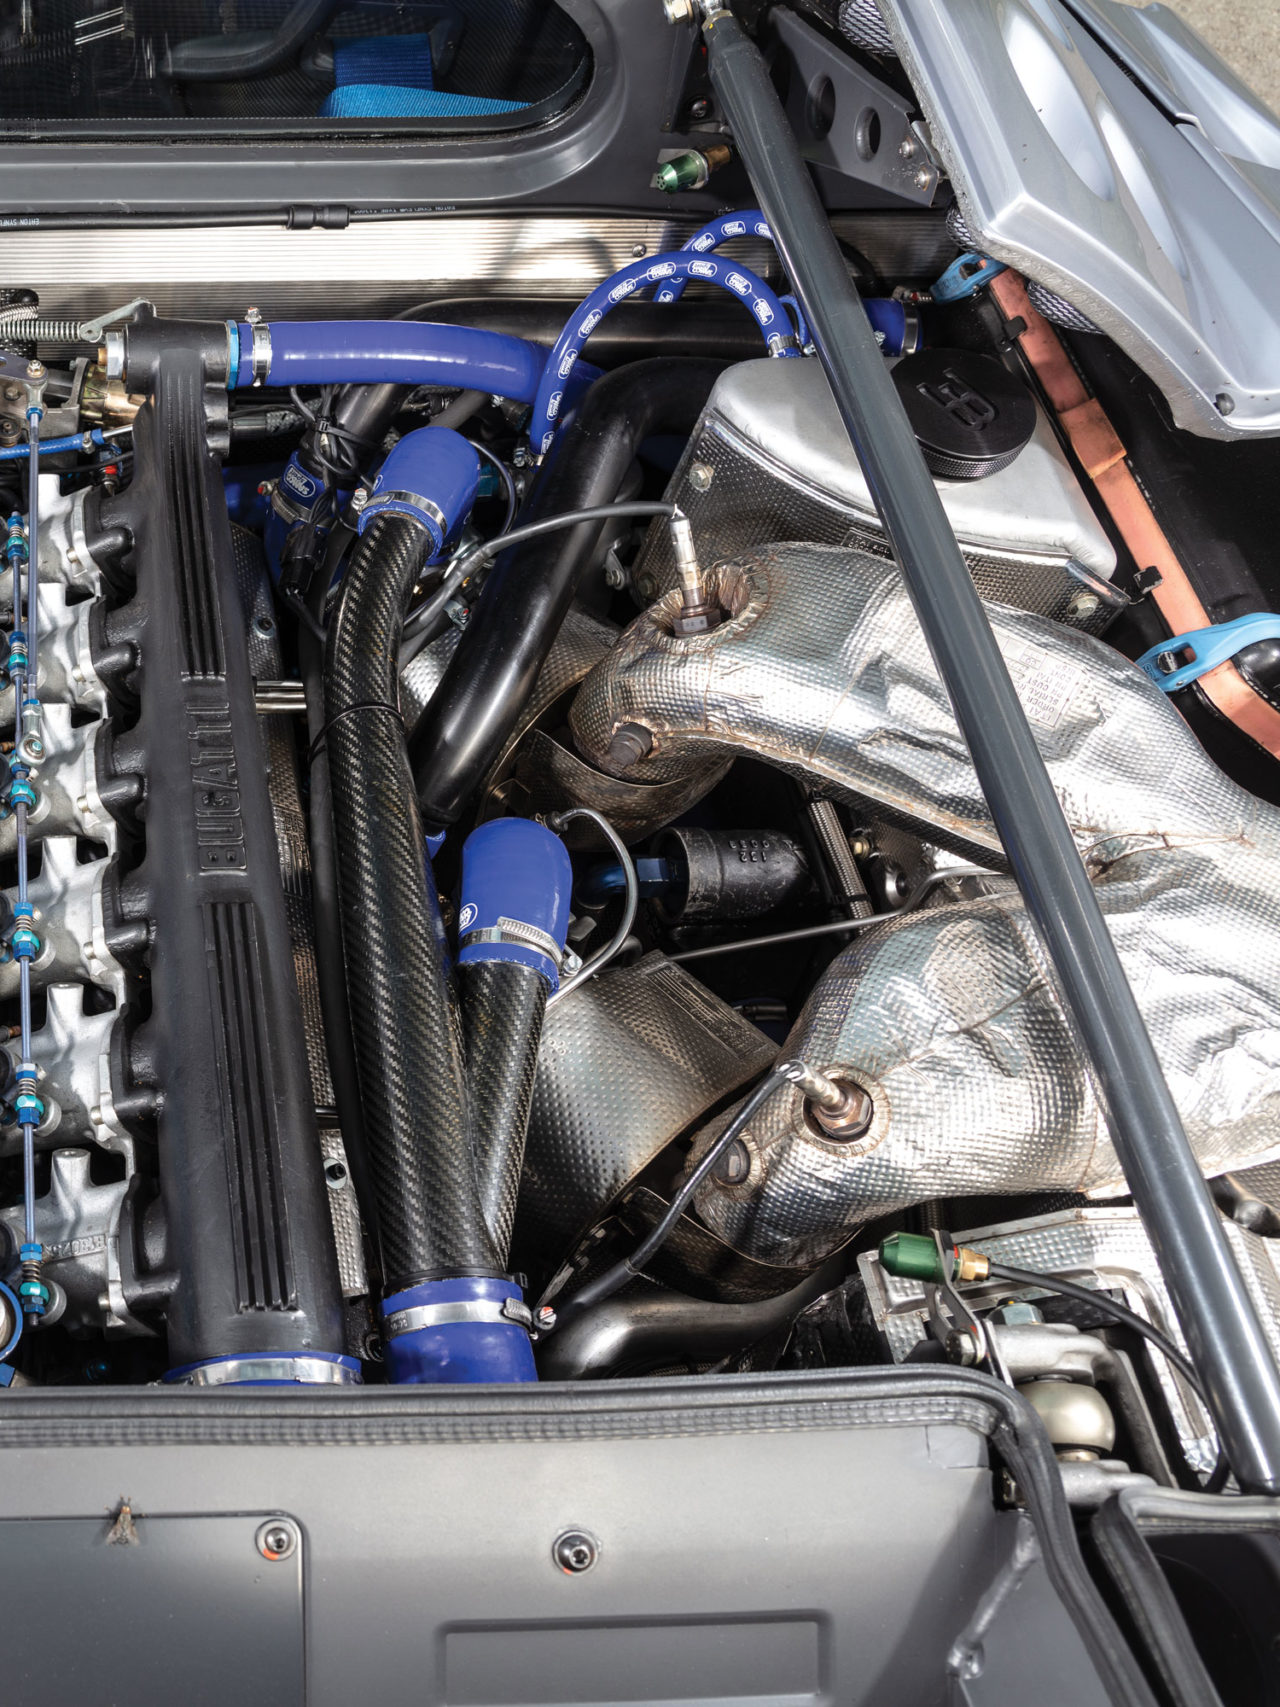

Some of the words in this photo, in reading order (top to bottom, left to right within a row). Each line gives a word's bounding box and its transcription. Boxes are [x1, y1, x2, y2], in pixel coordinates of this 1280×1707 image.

[286, 475, 310, 495] SAMCO
[1027, 677, 1049, 691] CUST
[1026, 695, 1055, 713] ORDER
[1029, 687, 1059, 705] SERIAL
[185, 702, 248, 876] BUGATTI
[739, 851, 767, 862] 132
